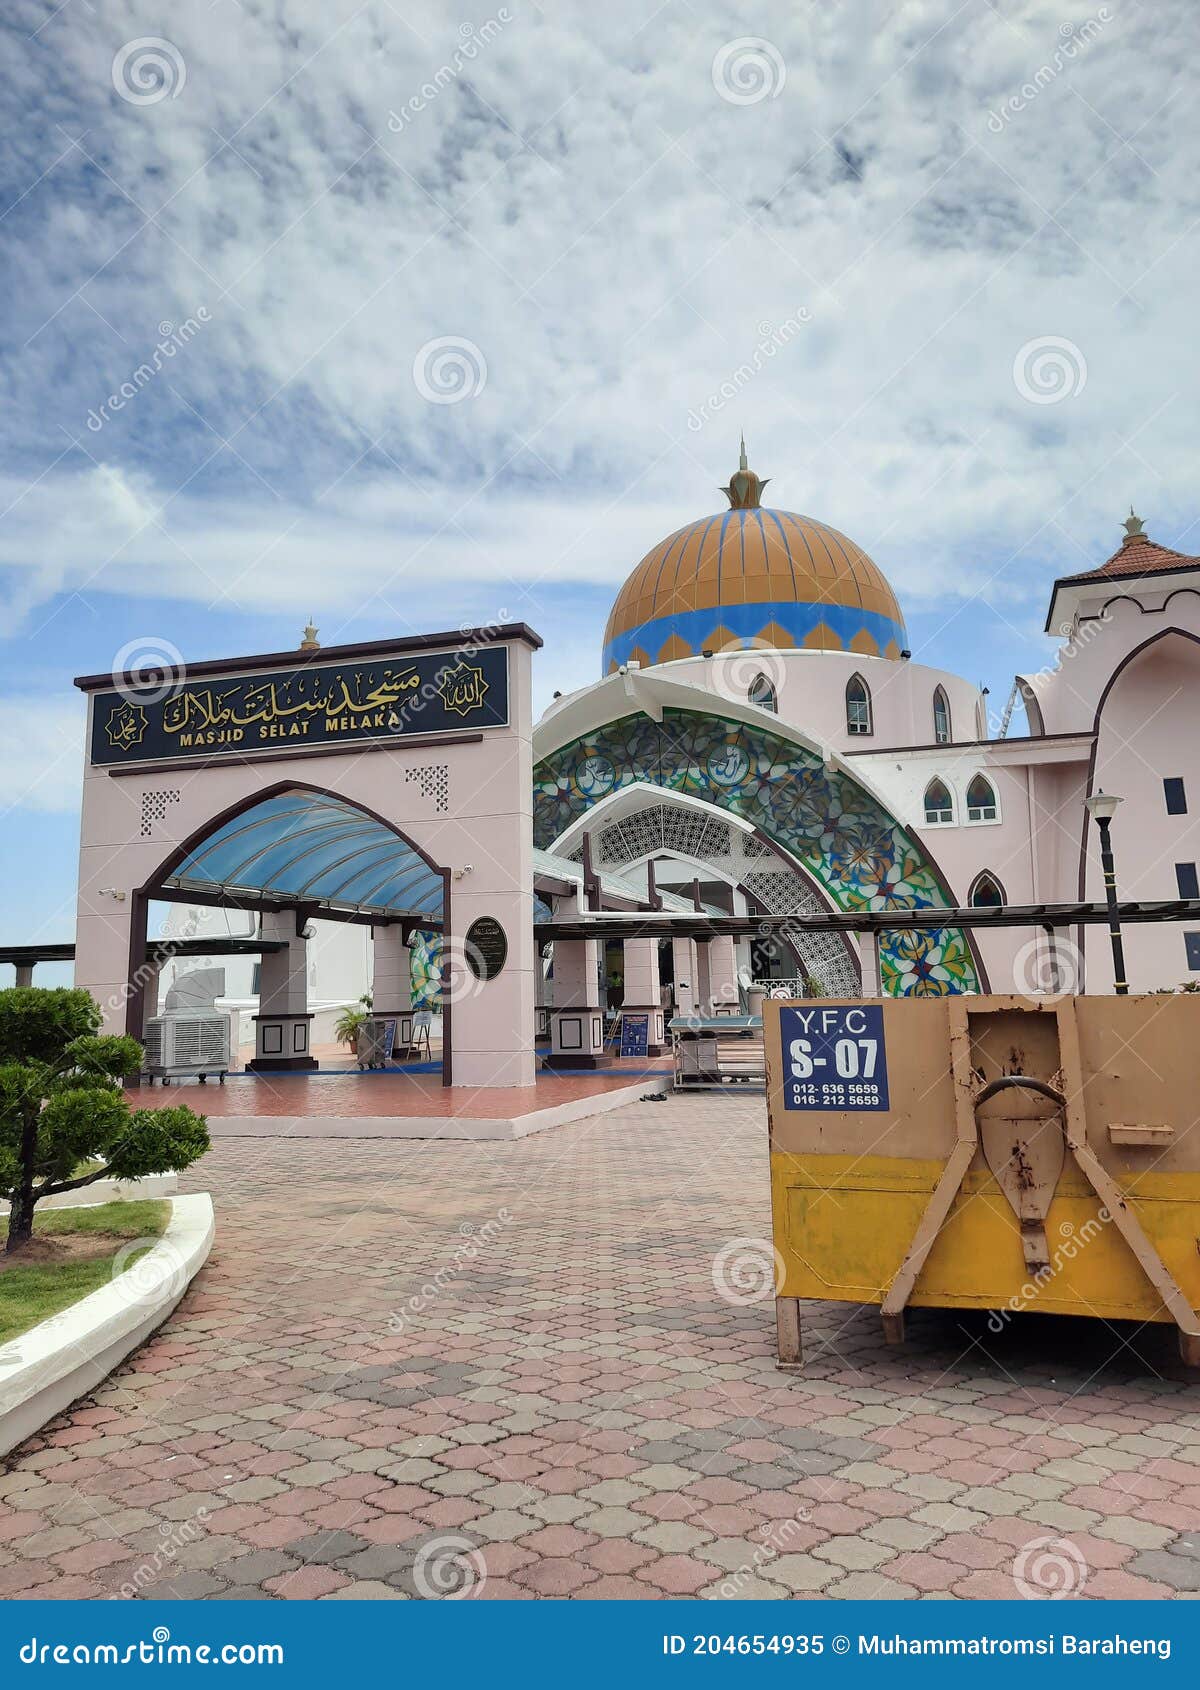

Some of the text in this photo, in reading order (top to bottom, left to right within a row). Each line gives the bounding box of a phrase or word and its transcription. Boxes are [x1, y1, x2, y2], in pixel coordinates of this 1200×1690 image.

[180, 711, 400, 747] MASJID SELAT MELAKA
[795, 1009, 867, 1034] Y.F.C
[793, 1084, 879, 1094] 012- 636 5659
[793, 1095, 879, 1105] 016- 212 5659
